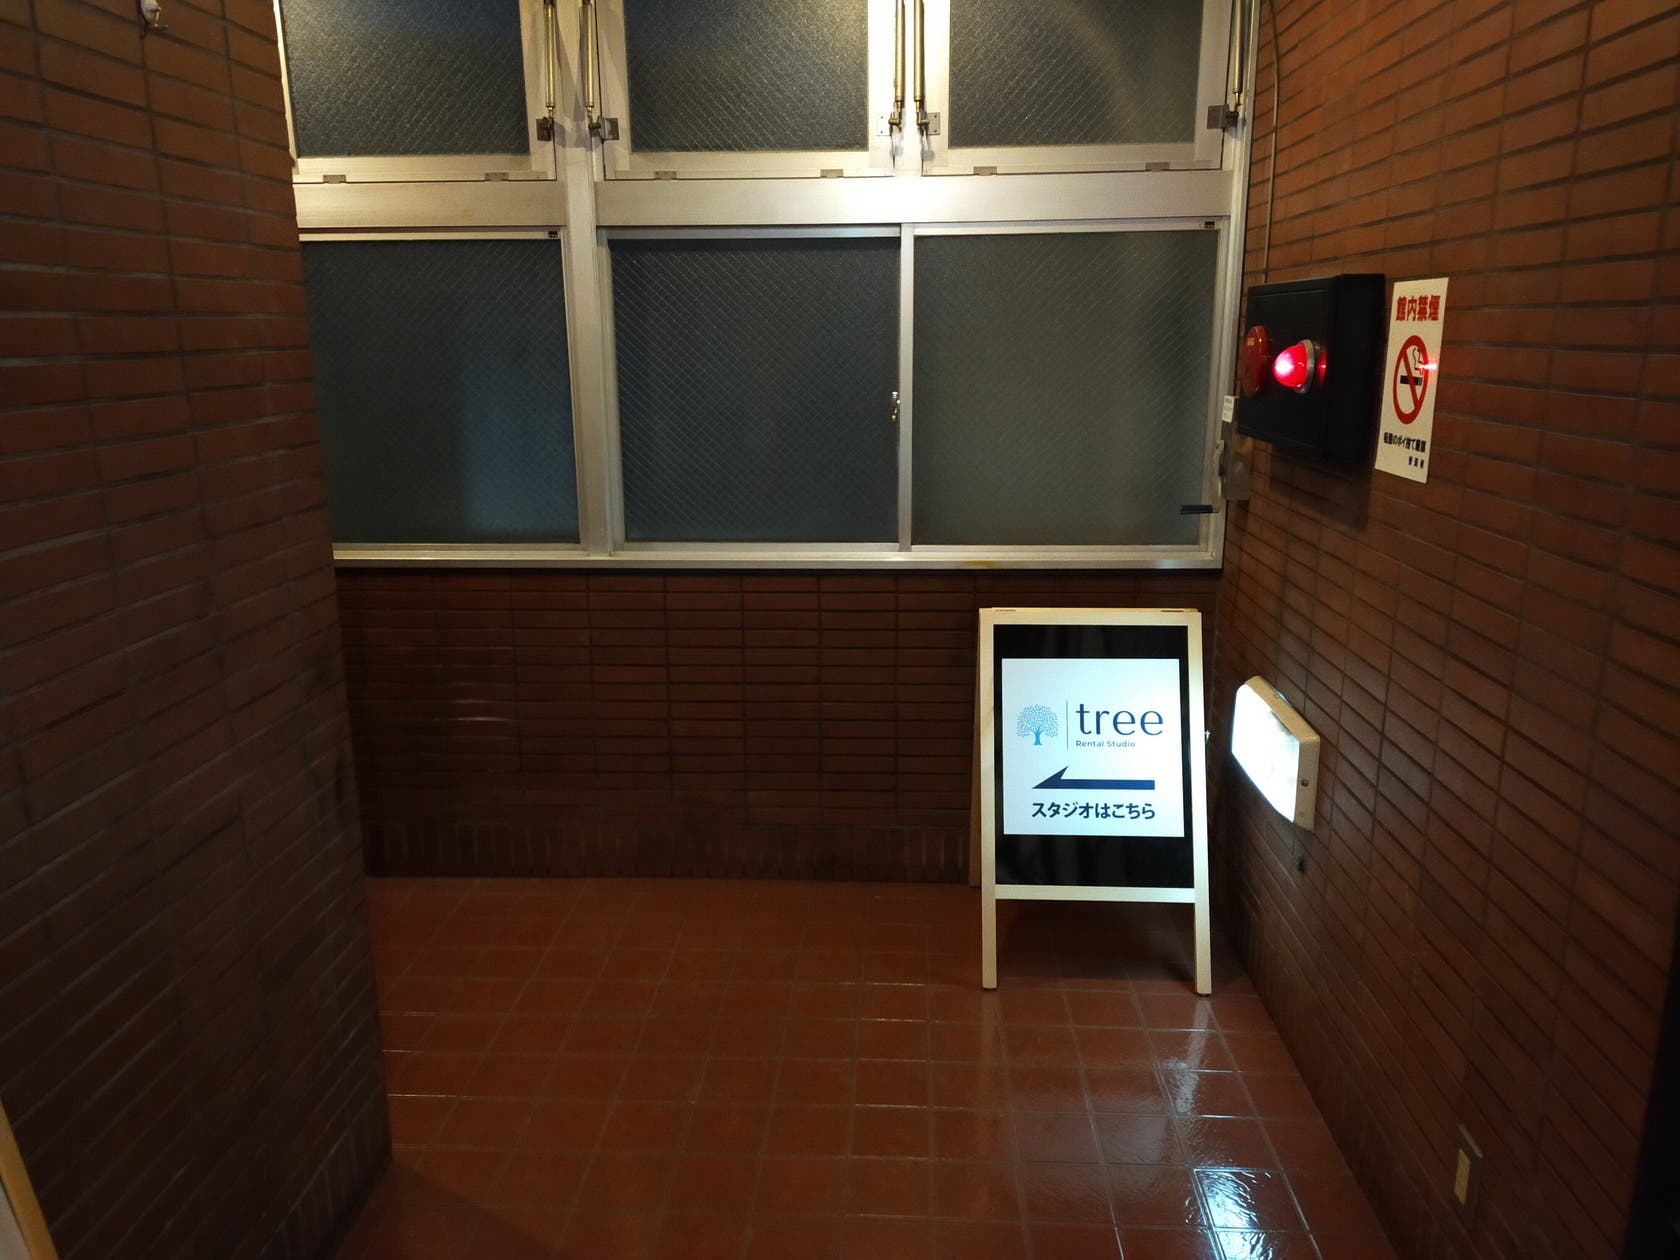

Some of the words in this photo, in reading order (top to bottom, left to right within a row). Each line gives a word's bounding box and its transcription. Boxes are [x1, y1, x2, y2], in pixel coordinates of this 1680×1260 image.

[1395, 294, 1441, 322] 館内禁煙
[1075, 703, 1163, 736] tree
[1075, 740, 1104, 748] Rental
[1106, 740, 1136, 748] Studio
[1031, 801, 1156, 820] スタジオはこちら
